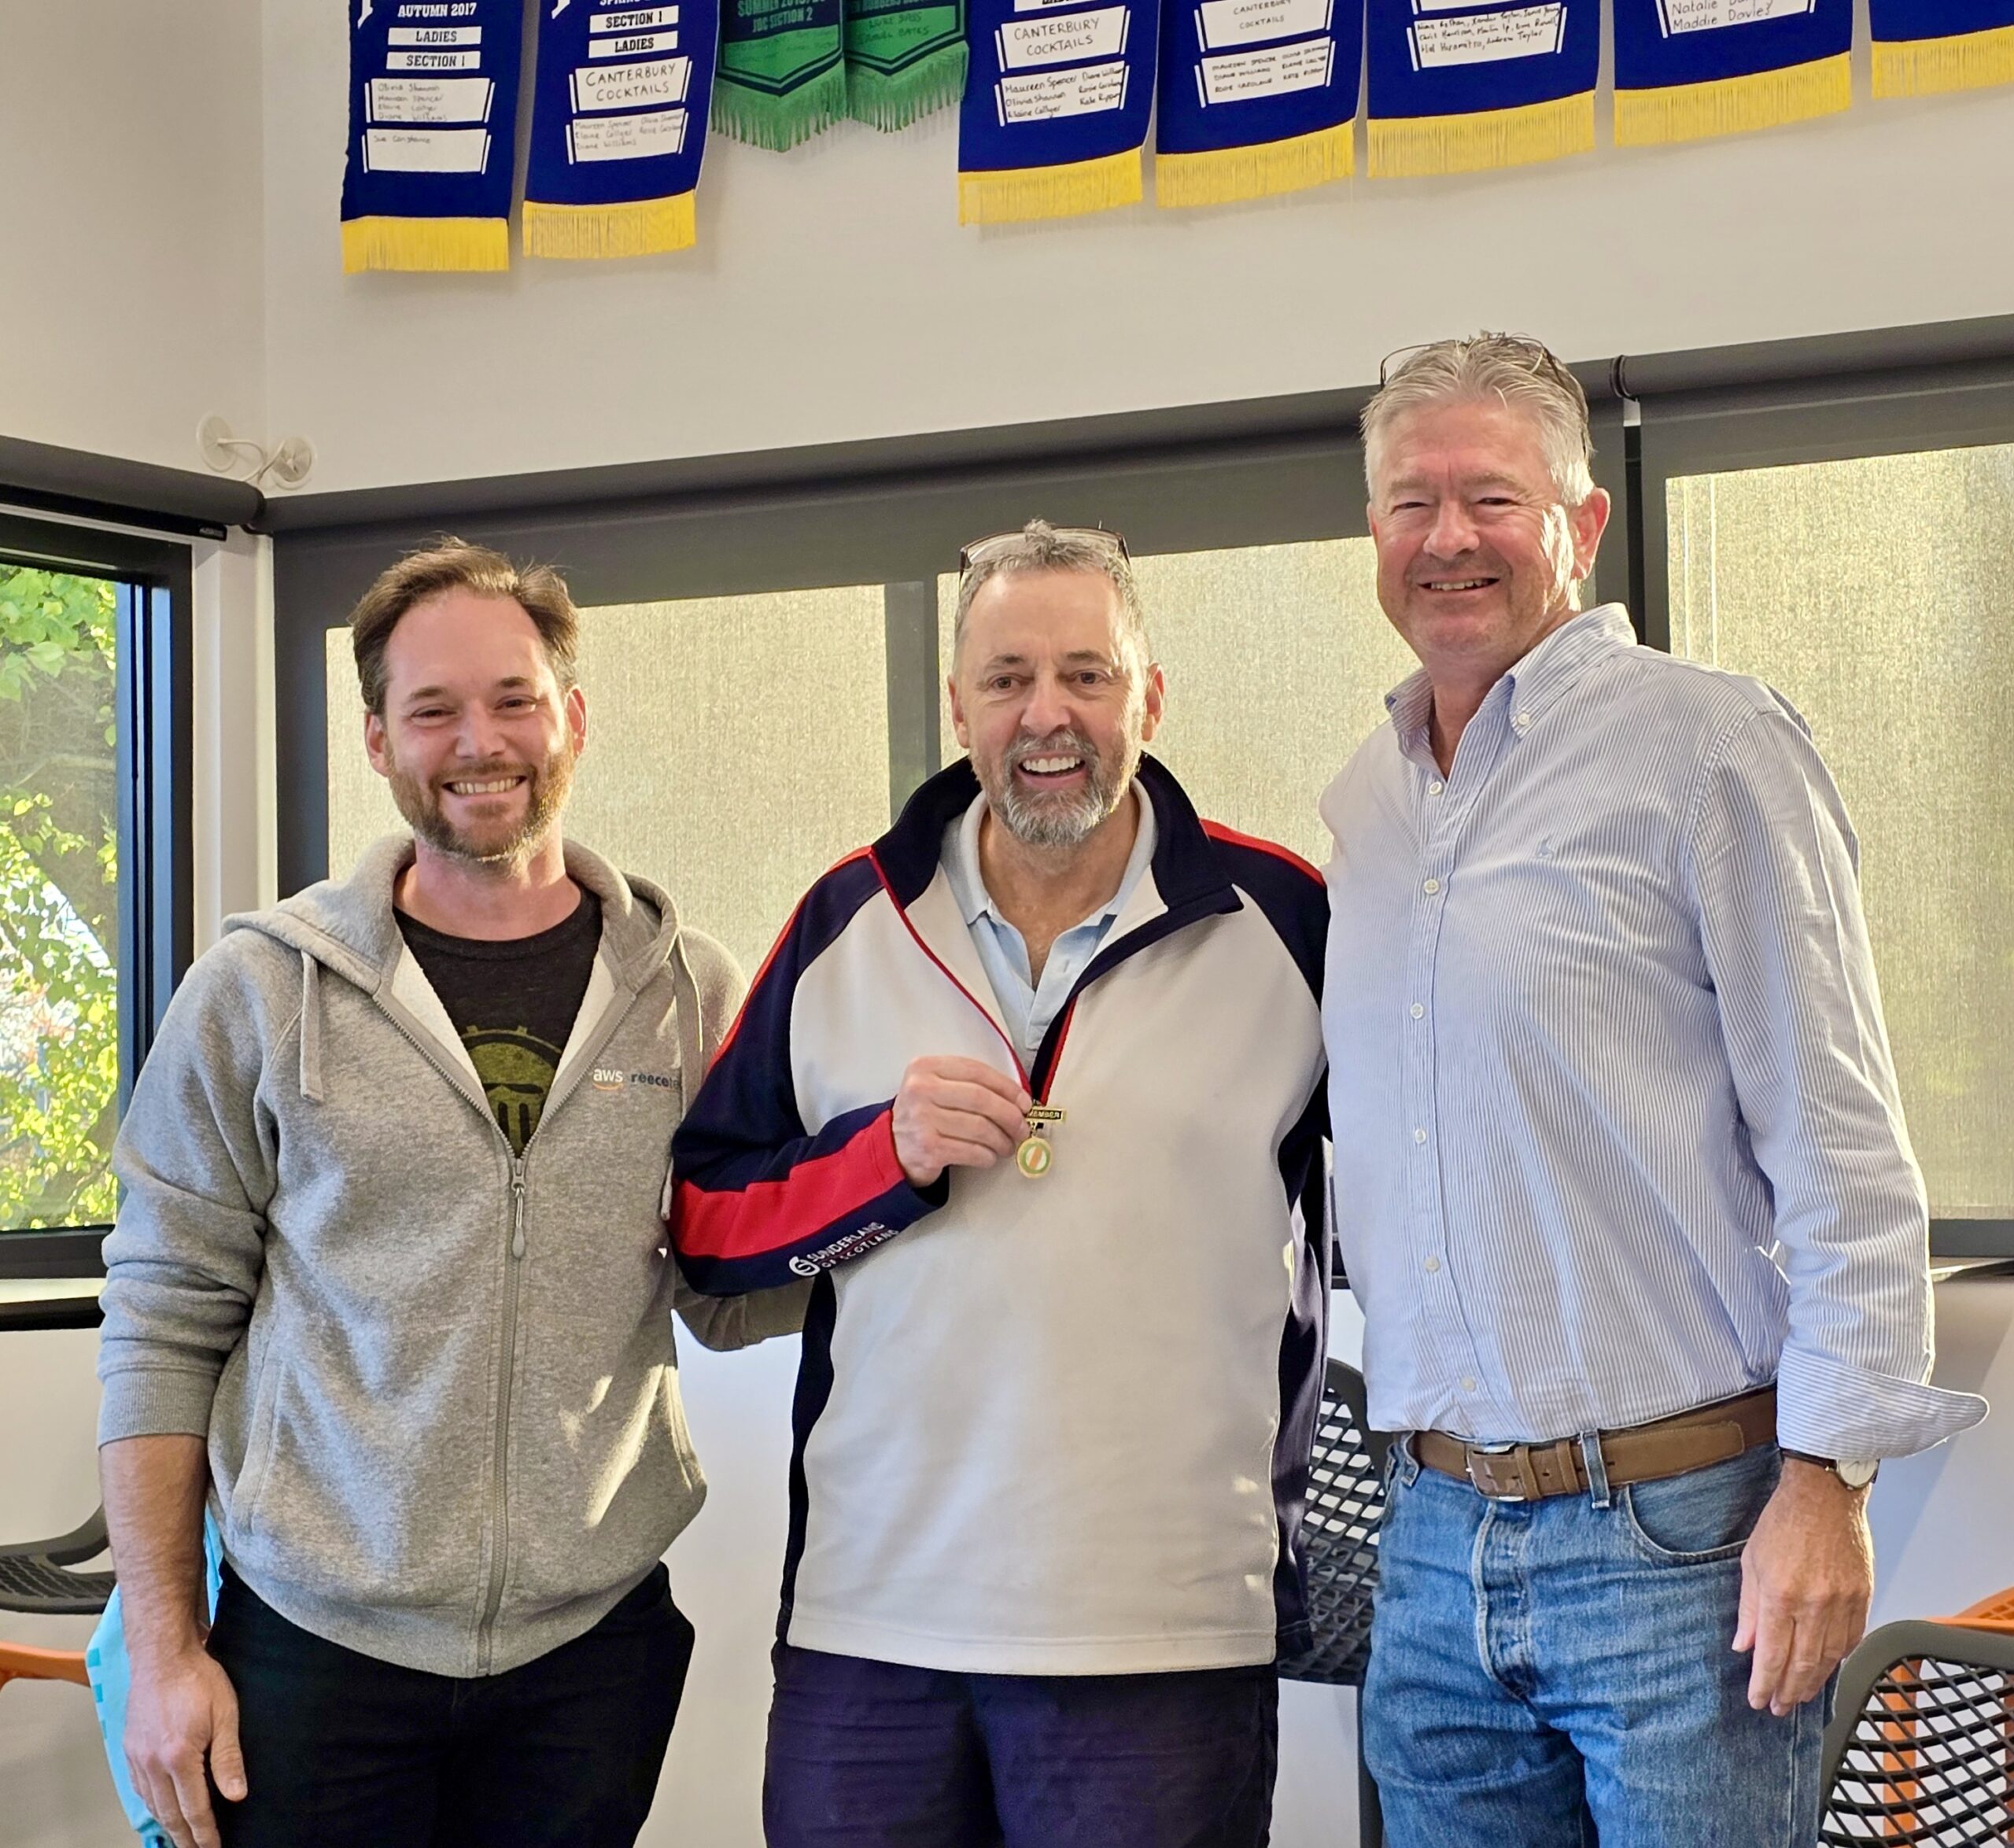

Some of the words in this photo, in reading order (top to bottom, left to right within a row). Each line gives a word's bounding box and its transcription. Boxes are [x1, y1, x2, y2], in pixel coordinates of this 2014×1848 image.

[397, 4, 448, 18] AUTUMN
[451, 2, 477, 17] 2017
[1234, 0, 1291, 15] CANTERBURY
[1672, 0, 1718, 16] Natalie
[606, 13, 653, 28] SECTION
[770, 8, 804, 28] SECTION
[806, 6, 813, 21] 2
[1239, 15, 1285, 29] COCKTAILS
[1673, 14, 1717, 31] Maddie
[415, 31, 457, 42] LADIES
[1014, 17, 1100, 40] CANTERBURY
[614, 37, 654, 53] LADIES
[1027, 35, 1094, 56] COCKTAILS
[406, 55, 456, 67] SECTION
[585, 63, 676, 87] CANTERBURY
[596, 81, 669, 101] COCKTAILS
[1005, 83, 1045, 93] Maureen
[1046, 75, 1077, 89] Spencer
[593, 1068, 623, 1083] aws
[807, 1222, 885, 1262] SUNDERLAND
